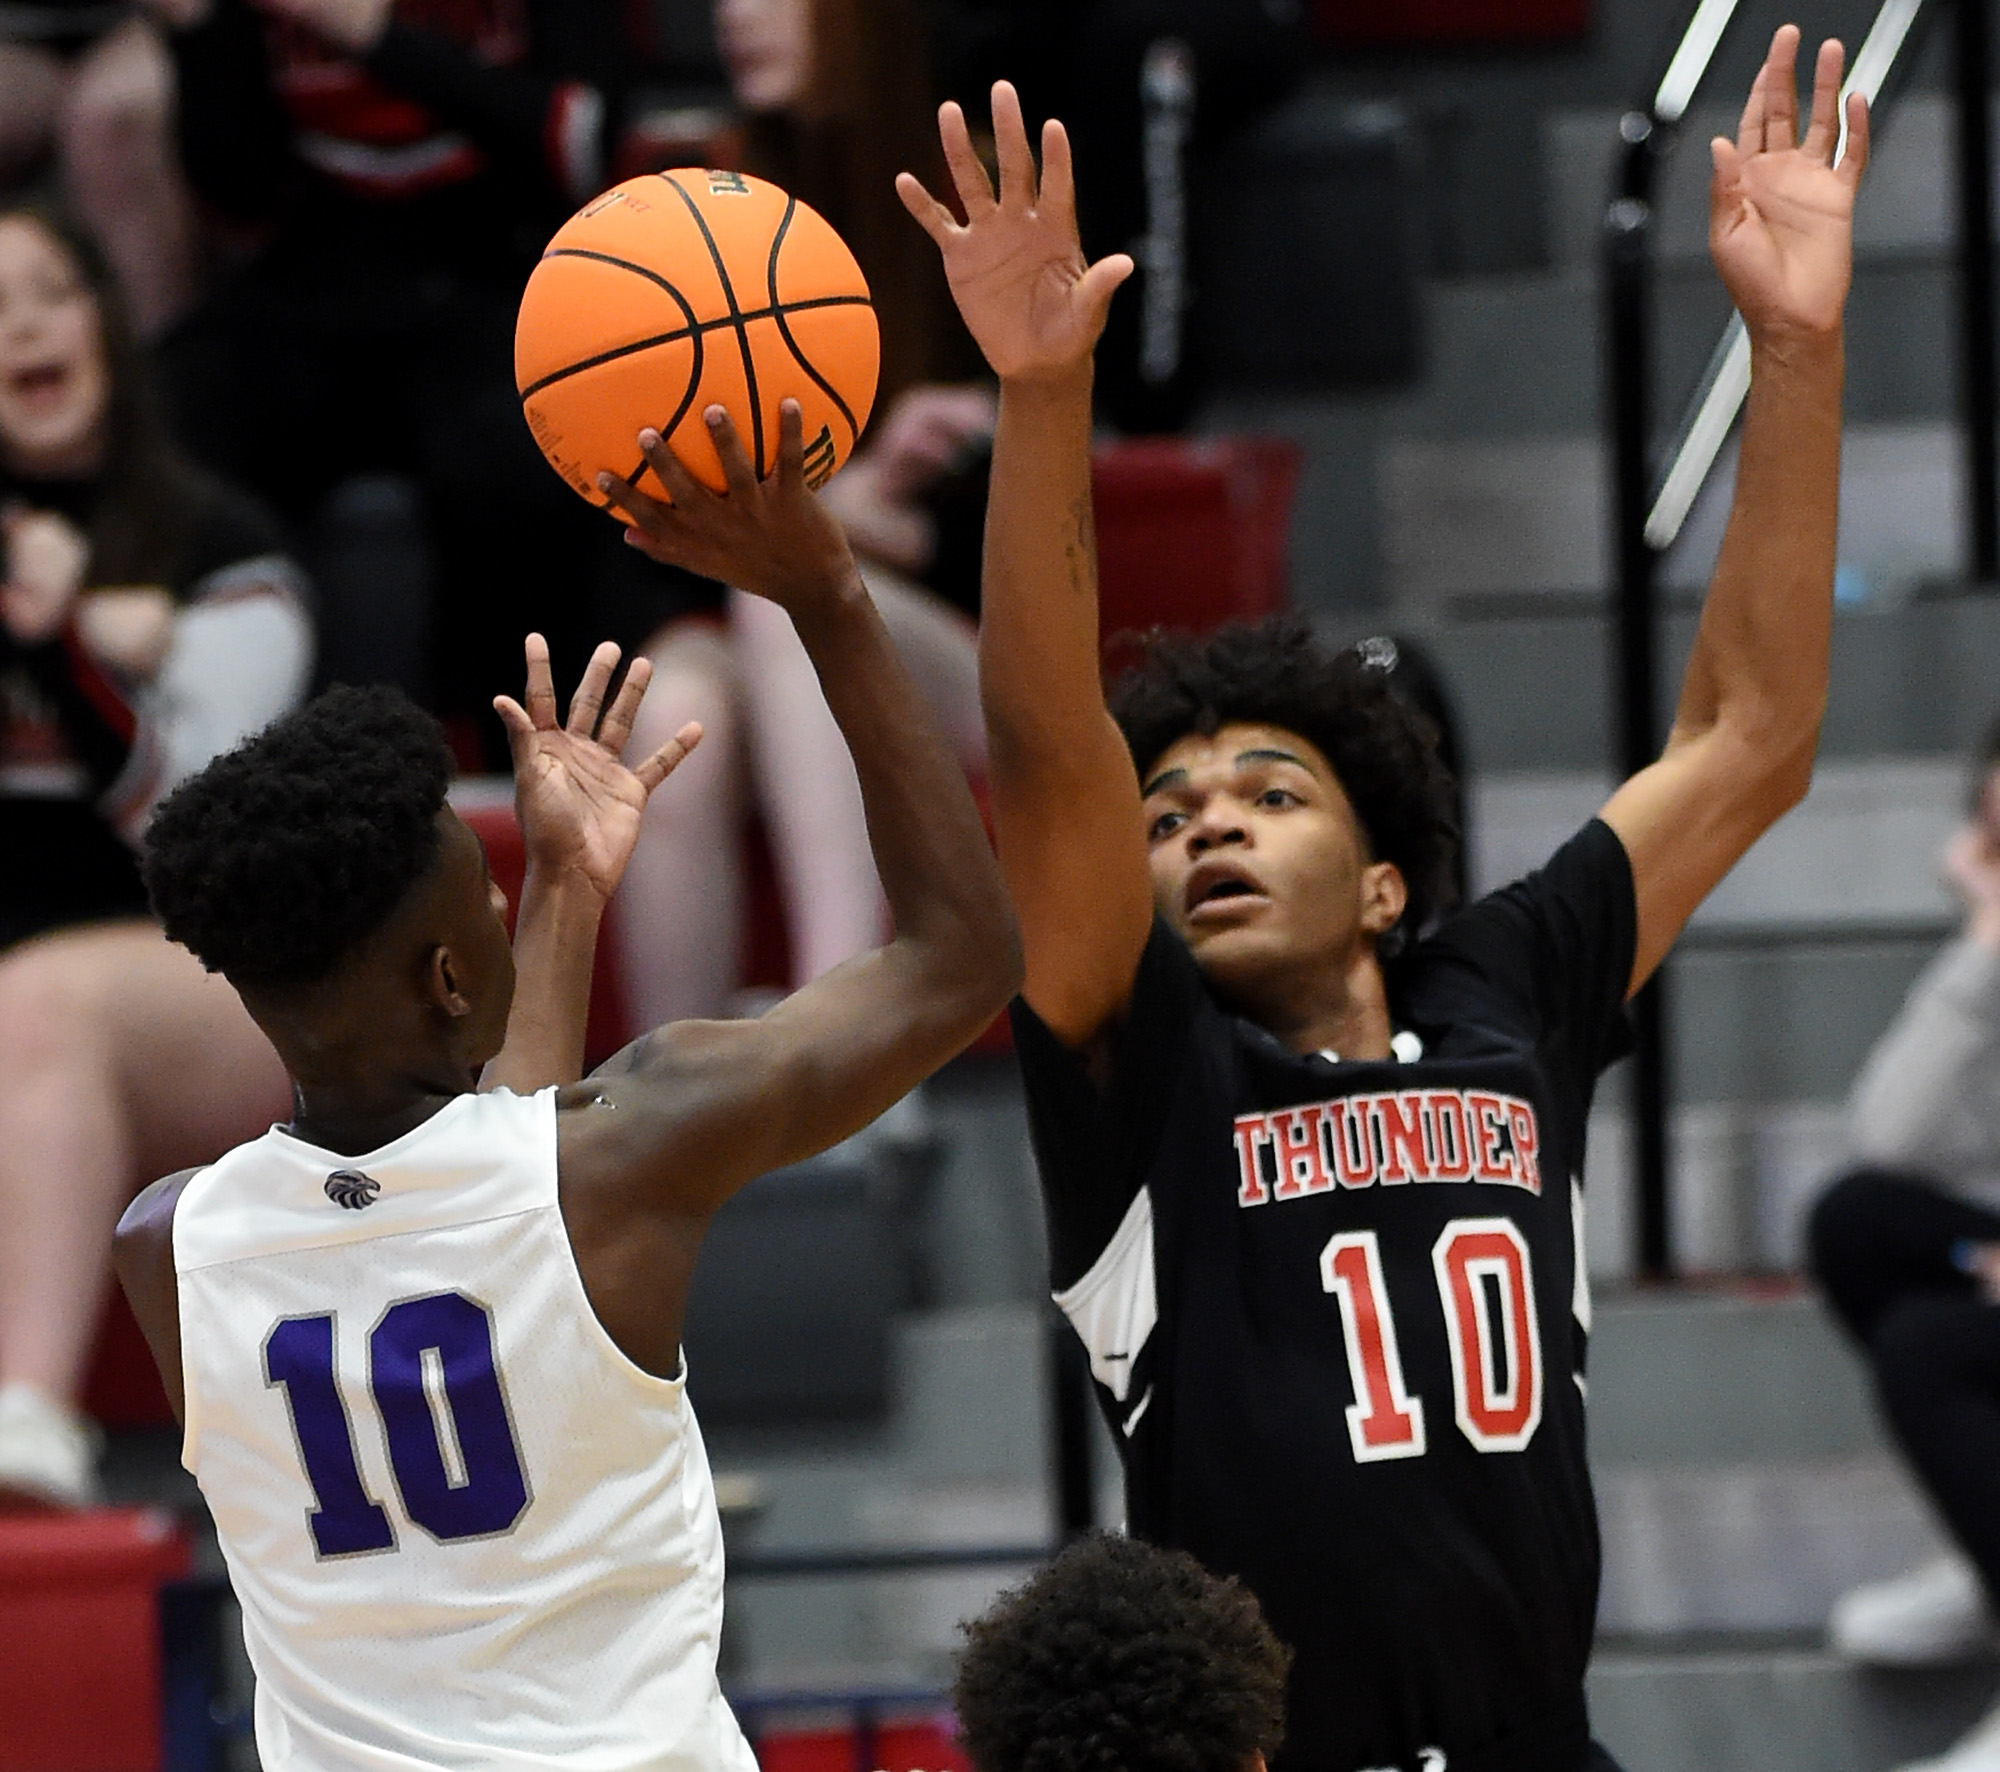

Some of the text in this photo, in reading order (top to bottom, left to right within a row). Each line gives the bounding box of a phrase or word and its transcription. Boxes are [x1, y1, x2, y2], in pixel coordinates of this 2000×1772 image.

[1233, 1089, 1541, 1208] THUNDER
[260, 1287, 536, 1563] 10
[1320, 1216, 1543, 1463] 10
